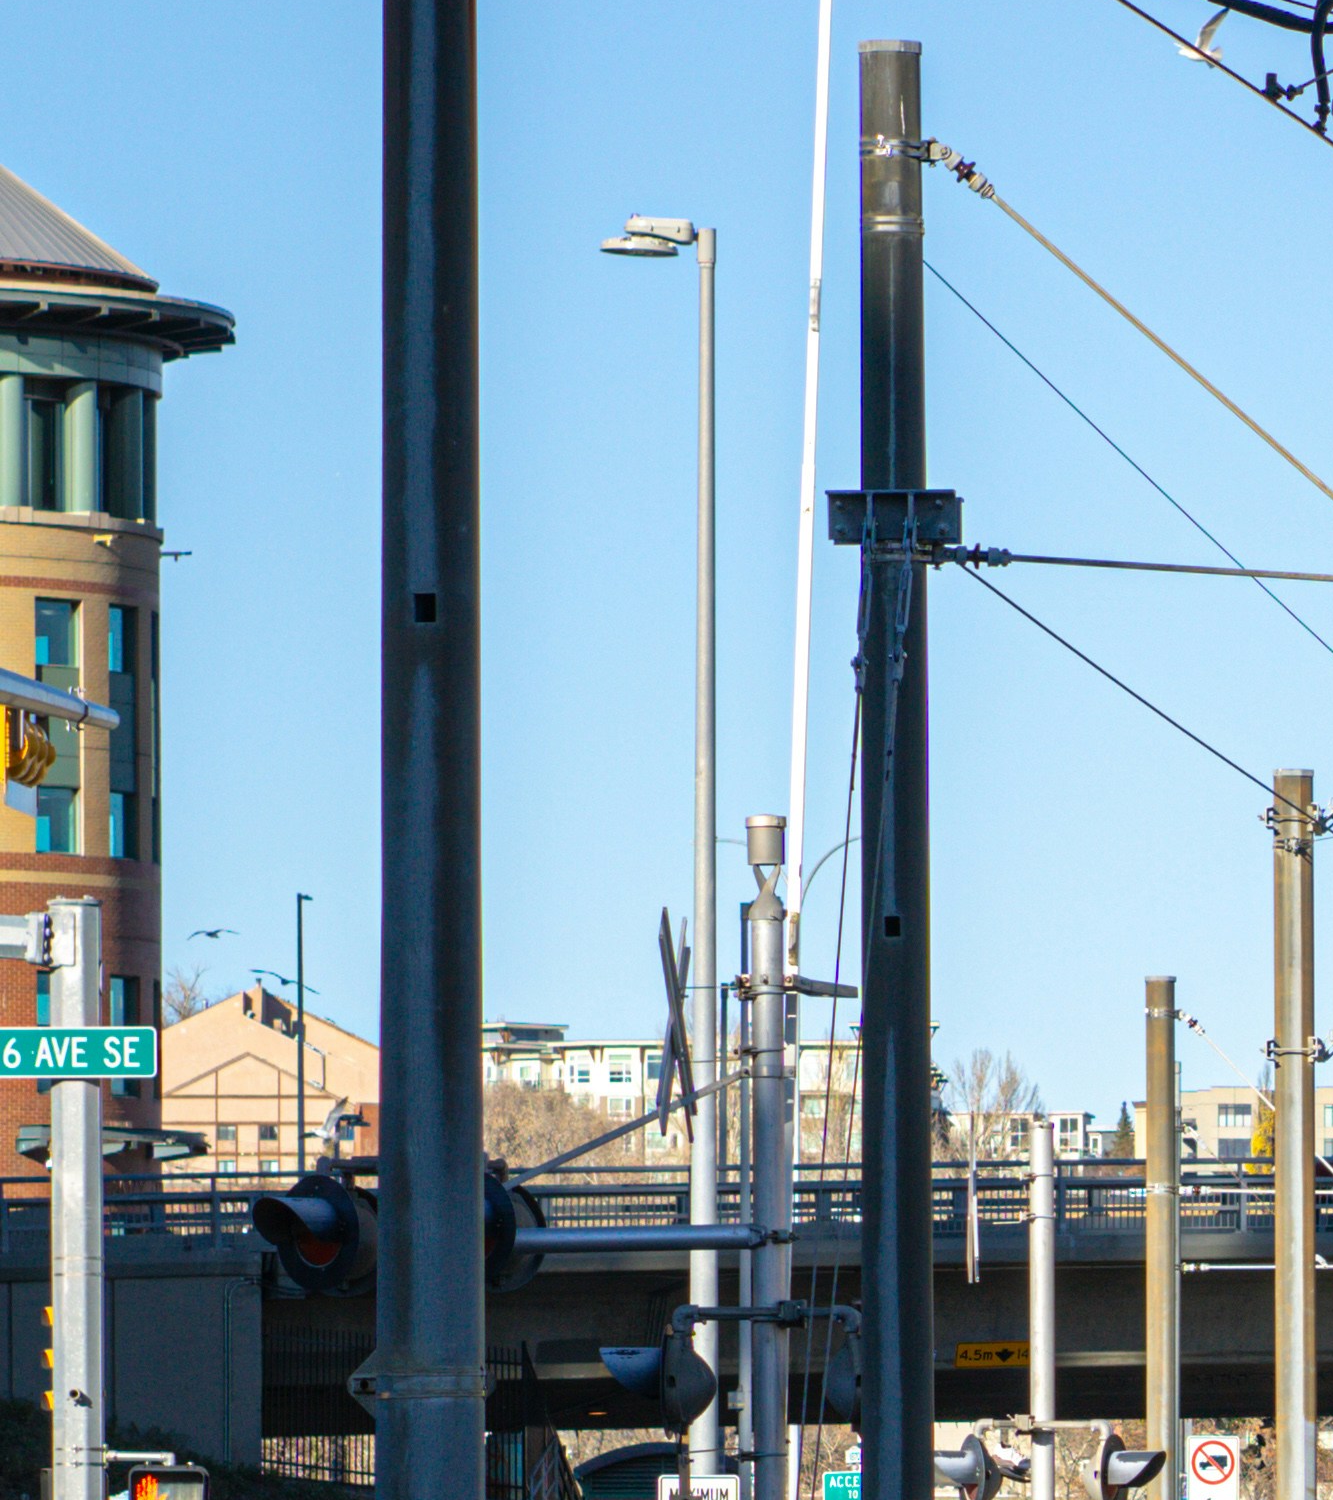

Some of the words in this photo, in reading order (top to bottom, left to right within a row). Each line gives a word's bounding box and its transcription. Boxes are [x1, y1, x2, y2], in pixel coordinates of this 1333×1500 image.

[3, 1037, 22, 1069] 6
[34, 1036, 88, 1068] AVE
[103, 1036, 141, 1068] SE
[959, 1349, 993, 1361] 4.5m
[1017, 1348, 1029, 1360] 14
[829, 1475, 861, 1488] ACCE
